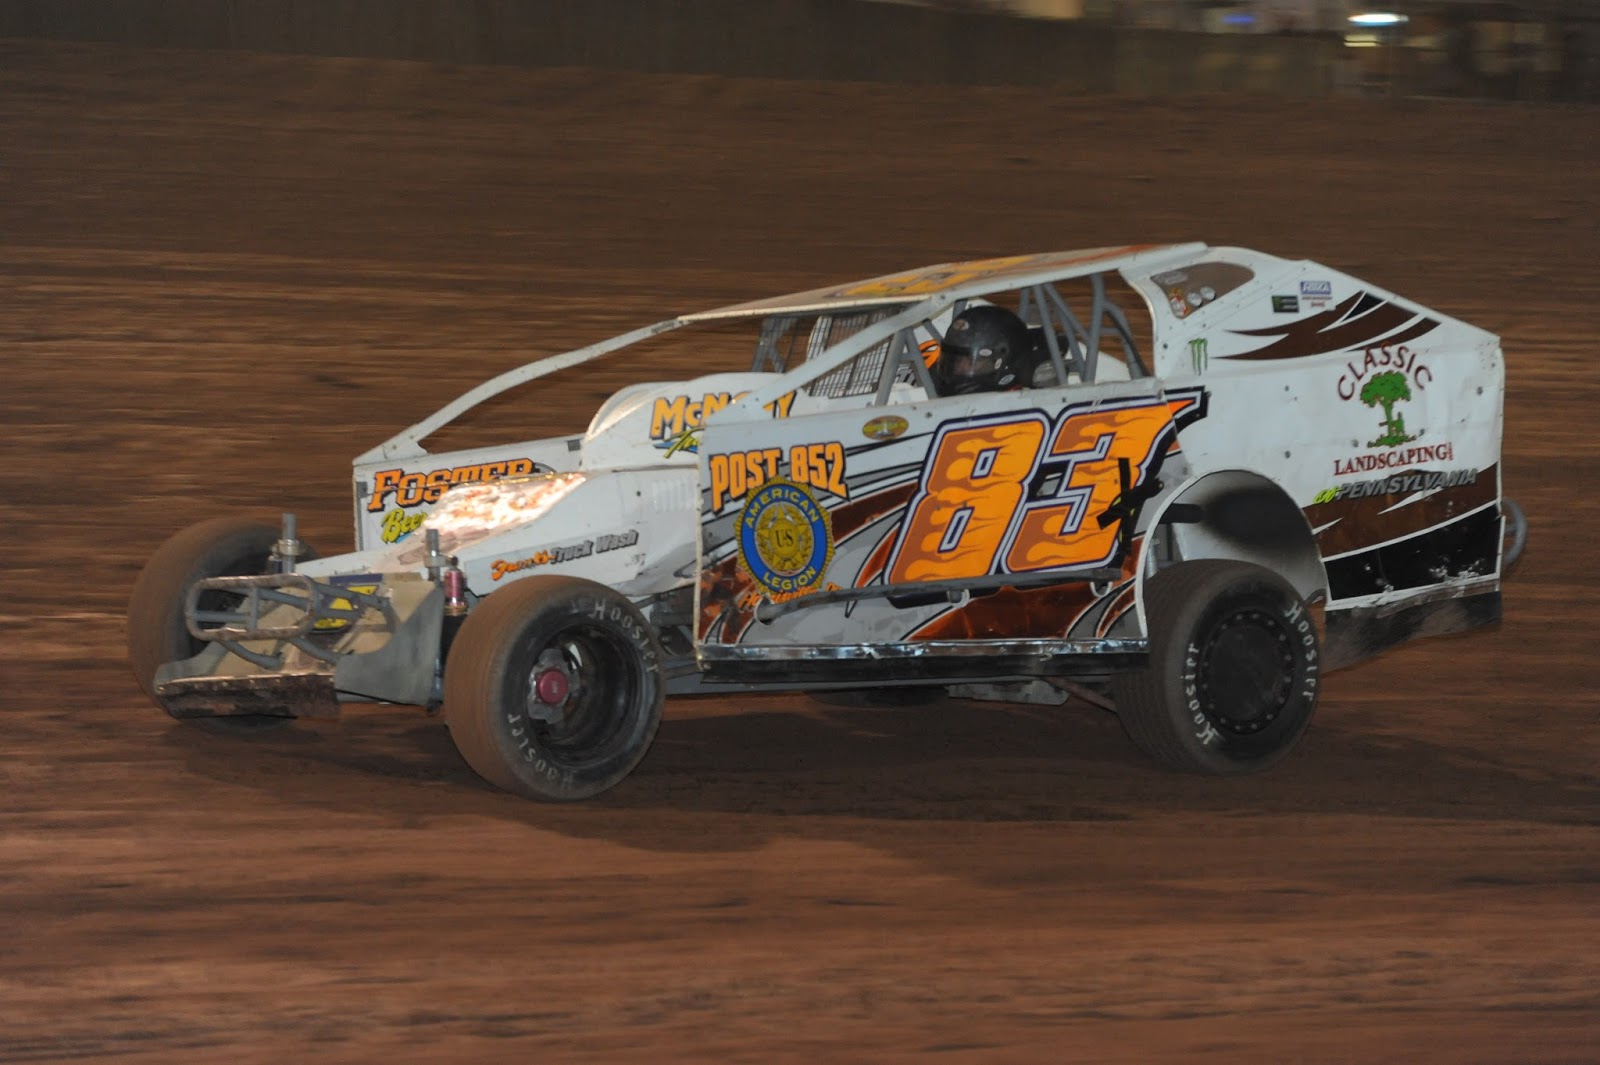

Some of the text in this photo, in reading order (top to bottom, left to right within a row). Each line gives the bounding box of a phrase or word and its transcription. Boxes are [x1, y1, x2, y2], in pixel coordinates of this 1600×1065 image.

[1337, 340, 1433, 402] CLASSIC
[709, 440, 850, 515] POST 852
[1333, 444, 1448, 476] LANDSCAPING
[883, 386, 1208, 586] 83
[1336, 467, 1480, 500] PENNSYLVANIA
[745, 488, 820, 528] AMERICAN
[595, 529, 639, 553] Wash
[763, 566, 817, 590] LEGION
